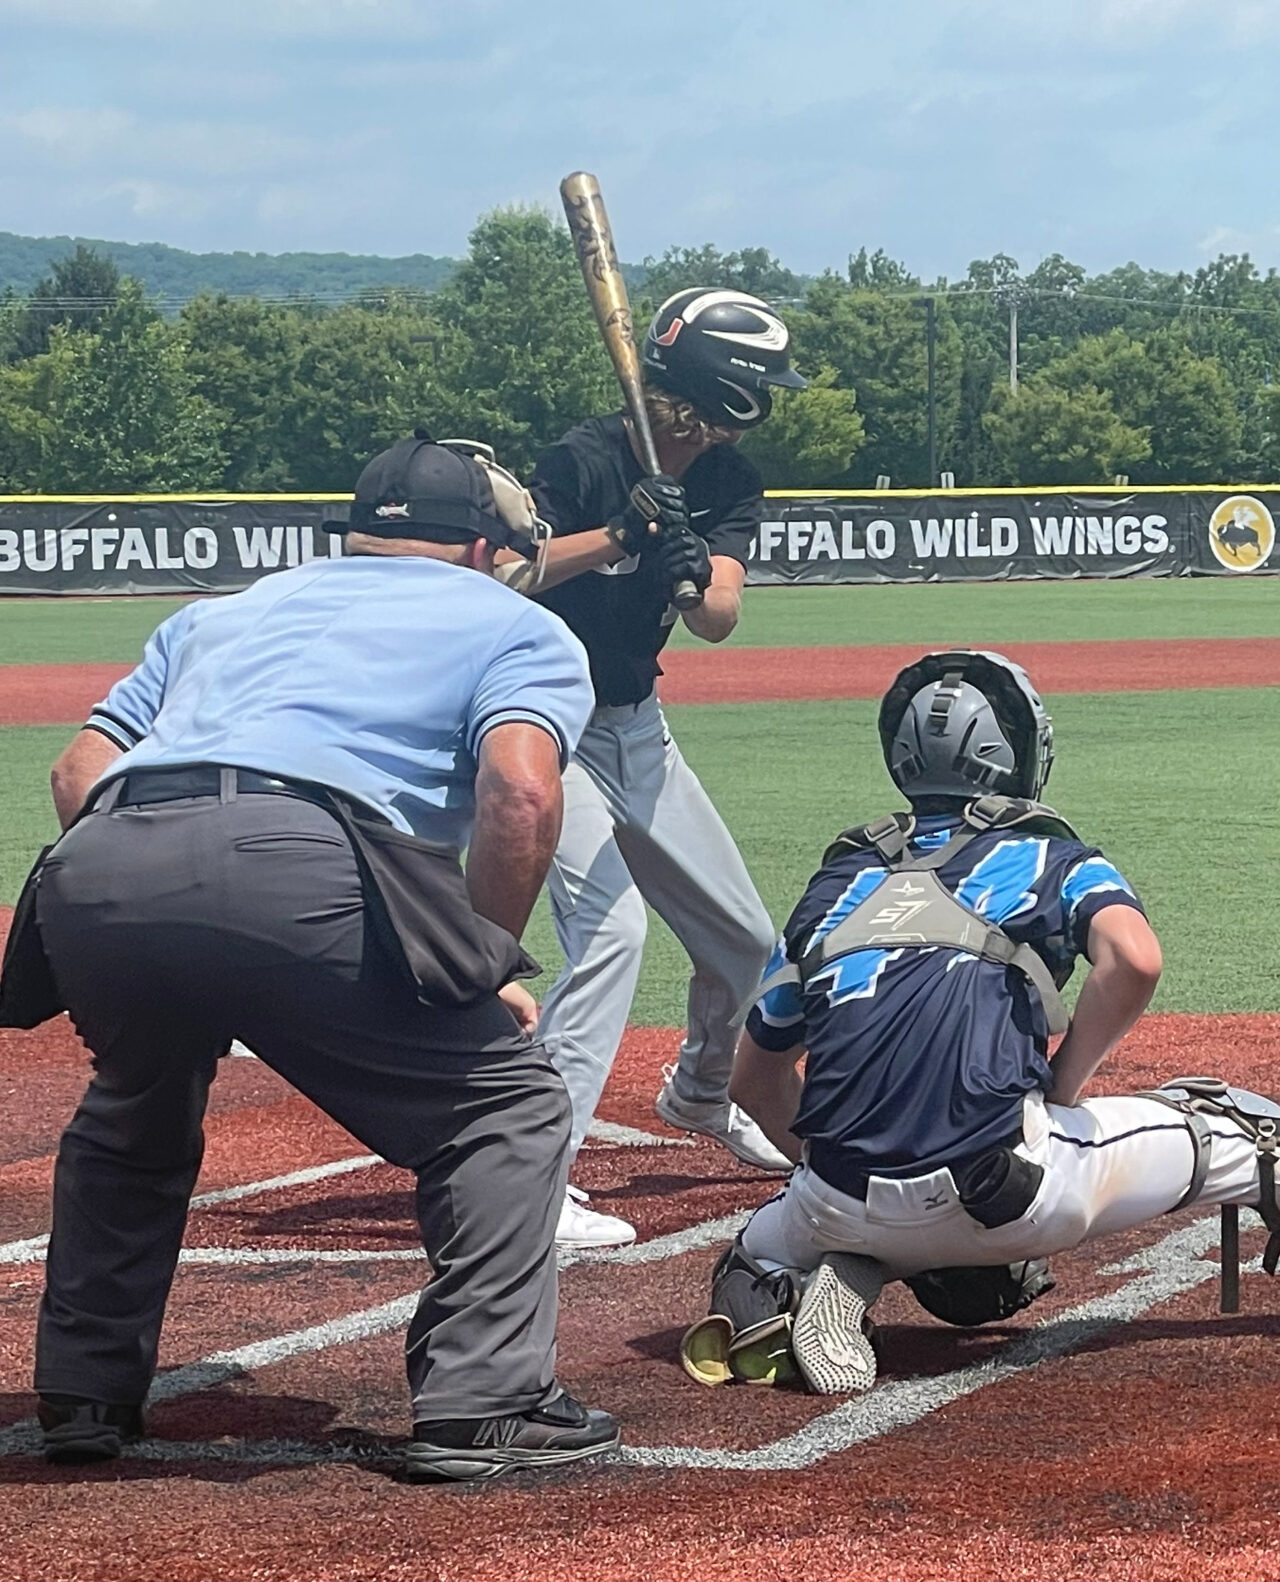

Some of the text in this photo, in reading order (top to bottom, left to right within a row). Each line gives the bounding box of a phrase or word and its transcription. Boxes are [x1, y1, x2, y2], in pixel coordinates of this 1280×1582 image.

[0, 526, 342, 572] BUFFALO WIL
[909, 518, 1019, 557] WILD
